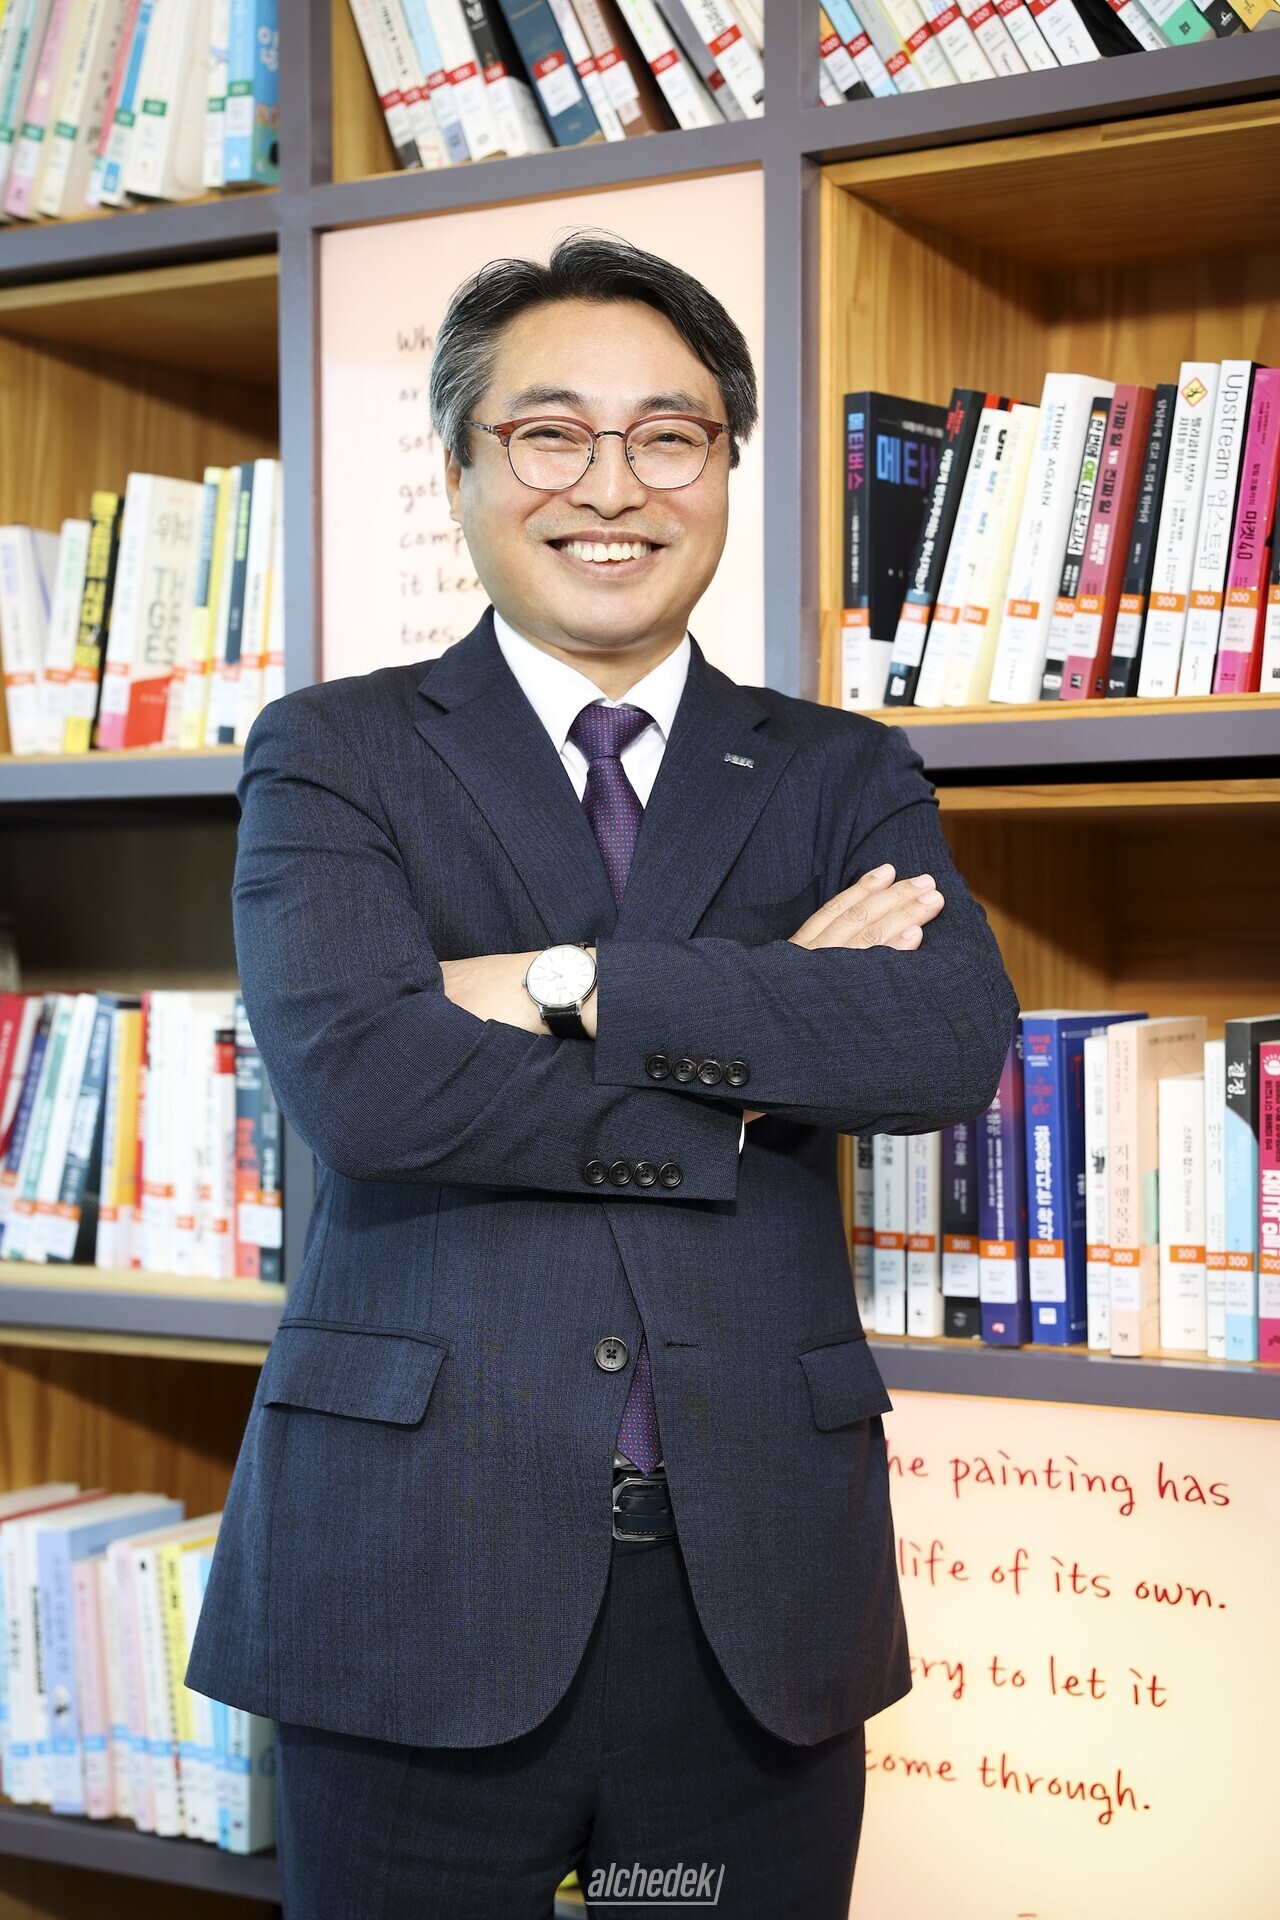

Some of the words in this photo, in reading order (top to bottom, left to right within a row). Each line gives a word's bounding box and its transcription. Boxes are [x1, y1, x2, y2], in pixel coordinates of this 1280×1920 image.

[936, 10, 954, 28] 100
[972, 7, 991, 26] 100
[820, 36, 840, 54] 100
[848, 35, 868, 54] 100
[910, 30, 928, 48] 100
[888, 54, 906, 73] 100
[398, 387, 422, 402] or
[1116, 400, 1128, 430] 가짜
[1051, 404, 1066, 451] THINK
[1091, 419, 1105, 431] 한
[1214, 374, 1244, 481] Upstream
[1084, 433, 1101, 458] 번에
[1110, 432, 1122, 446] 일
[1187, 417, 1202, 459] 헬리콥터
[847, 412, 864, 489] 메타버스
[877, 434, 937, 490] 메타
[1081, 459, 1096, 483] OK
[1041, 458, 1056, 506] AGAIN
[1101, 468, 1116, 497] 진짜
[399, 475, 440, 514] got
[1077, 483, 1092, 511] 나는
[1098, 499, 1111, 514] 일
[1070, 512, 1088, 551] 보고서
[1200, 490, 1228, 570] 업스트림
[1241, 510, 1257, 540] 마켓
[1237, 541, 1254, 560] 4.0
[399, 570, 423, 597] it
[1080, 599, 1098, 610] 300
[1120, 599, 1139, 609] 300
[1157, 596, 1177, 607] 300
[1196, 596, 1215, 606] 300
[1230, 592, 1250, 603] 300
[1013, 604, 1031, 614] 300
[1055, 602, 1075, 613] 300
[952, 1239, 971, 1250] 300
[987, 1244, 1006, 1256] 300
[1036, 1244, 1055, 1256] 300
[1091, 1248, 1110, 1259] 300
[1114, 1252, 1133, 1263] 300
[1177, 1249, 1197, 1260] 300
[1206, 1255, 1225, 1266] 300
[1228, 1255, 1248, 1266] 300
[950, 1451, 1136, 1516] painting
[1157, 1462, 1231, 1508] has
[898, 1538, 971, 1586] life
[991, 1547, 1029, 1595] of
[1051, 1556, 1111, 1599] its
[1135, 1579, 1228, 1609] own.
[989, 1656, 1026, 1688] to
[1051, 1655, 1107, 1700] let
[1130, 1668, 1168, 1708] it
[978, 1753, 1151, 1825] through.
